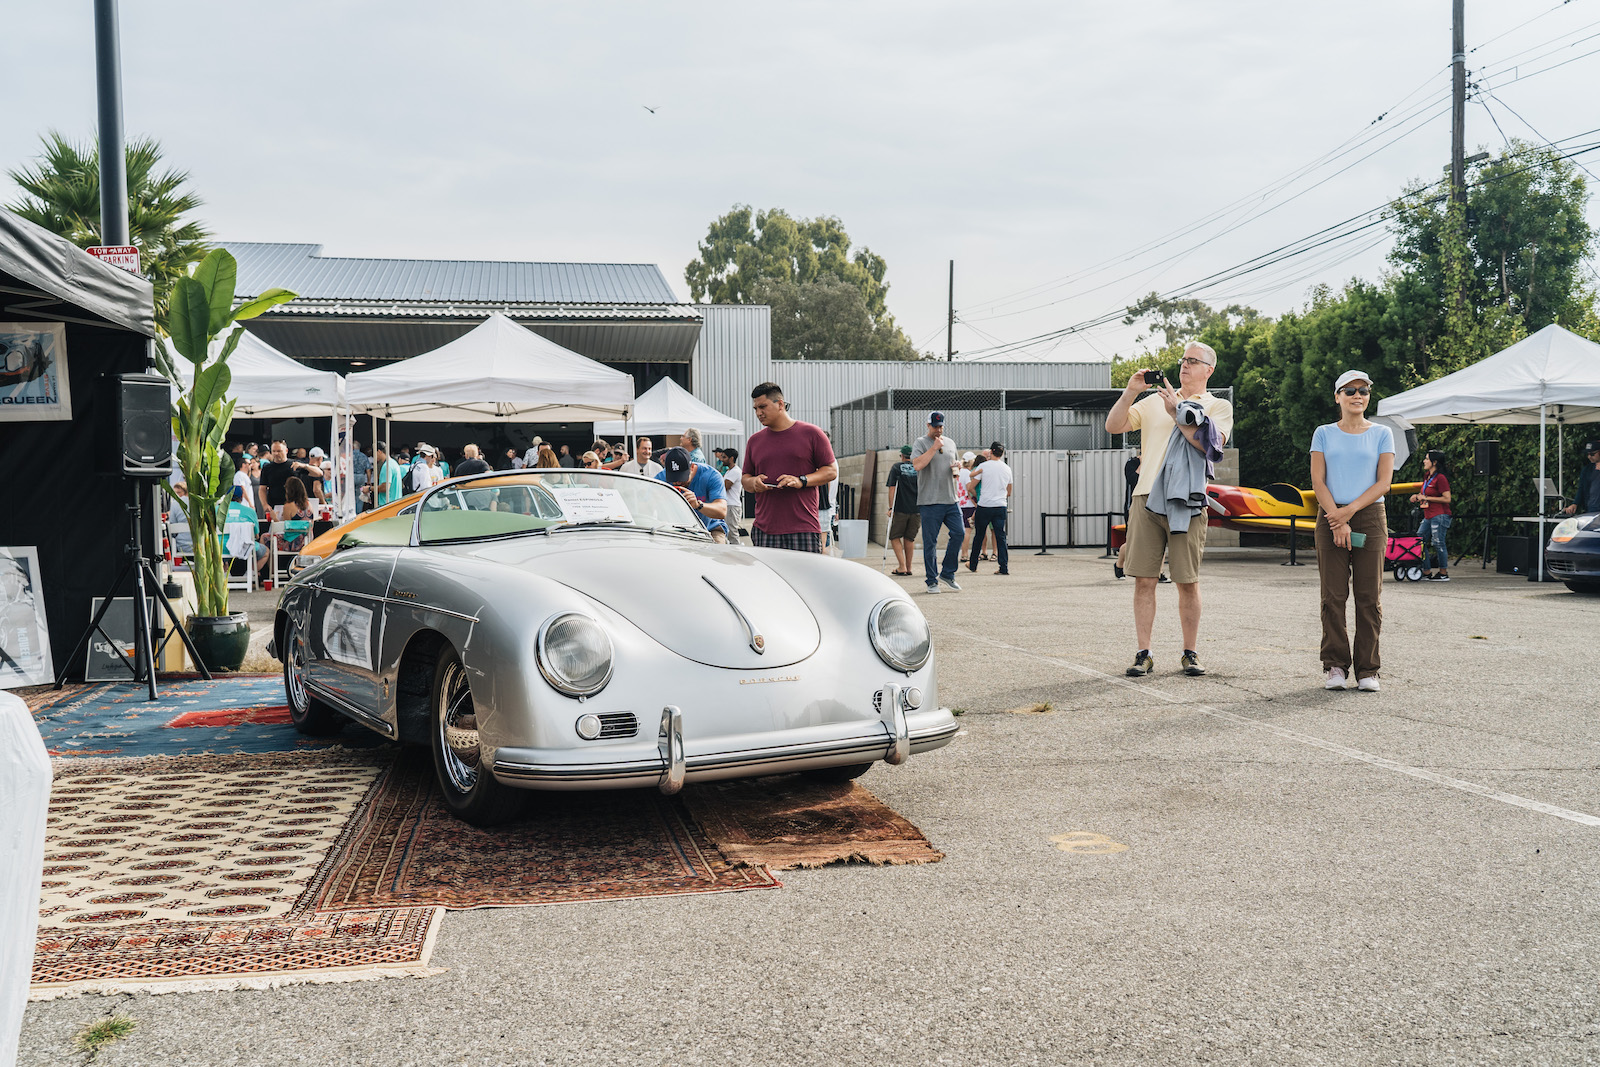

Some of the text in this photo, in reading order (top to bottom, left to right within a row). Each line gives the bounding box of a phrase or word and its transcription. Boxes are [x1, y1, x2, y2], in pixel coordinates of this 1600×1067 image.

[103, 255, 135, 264] PARKING
[0, 396, 57, 404] QUEEN
[671, 460, 680, 471] LA
